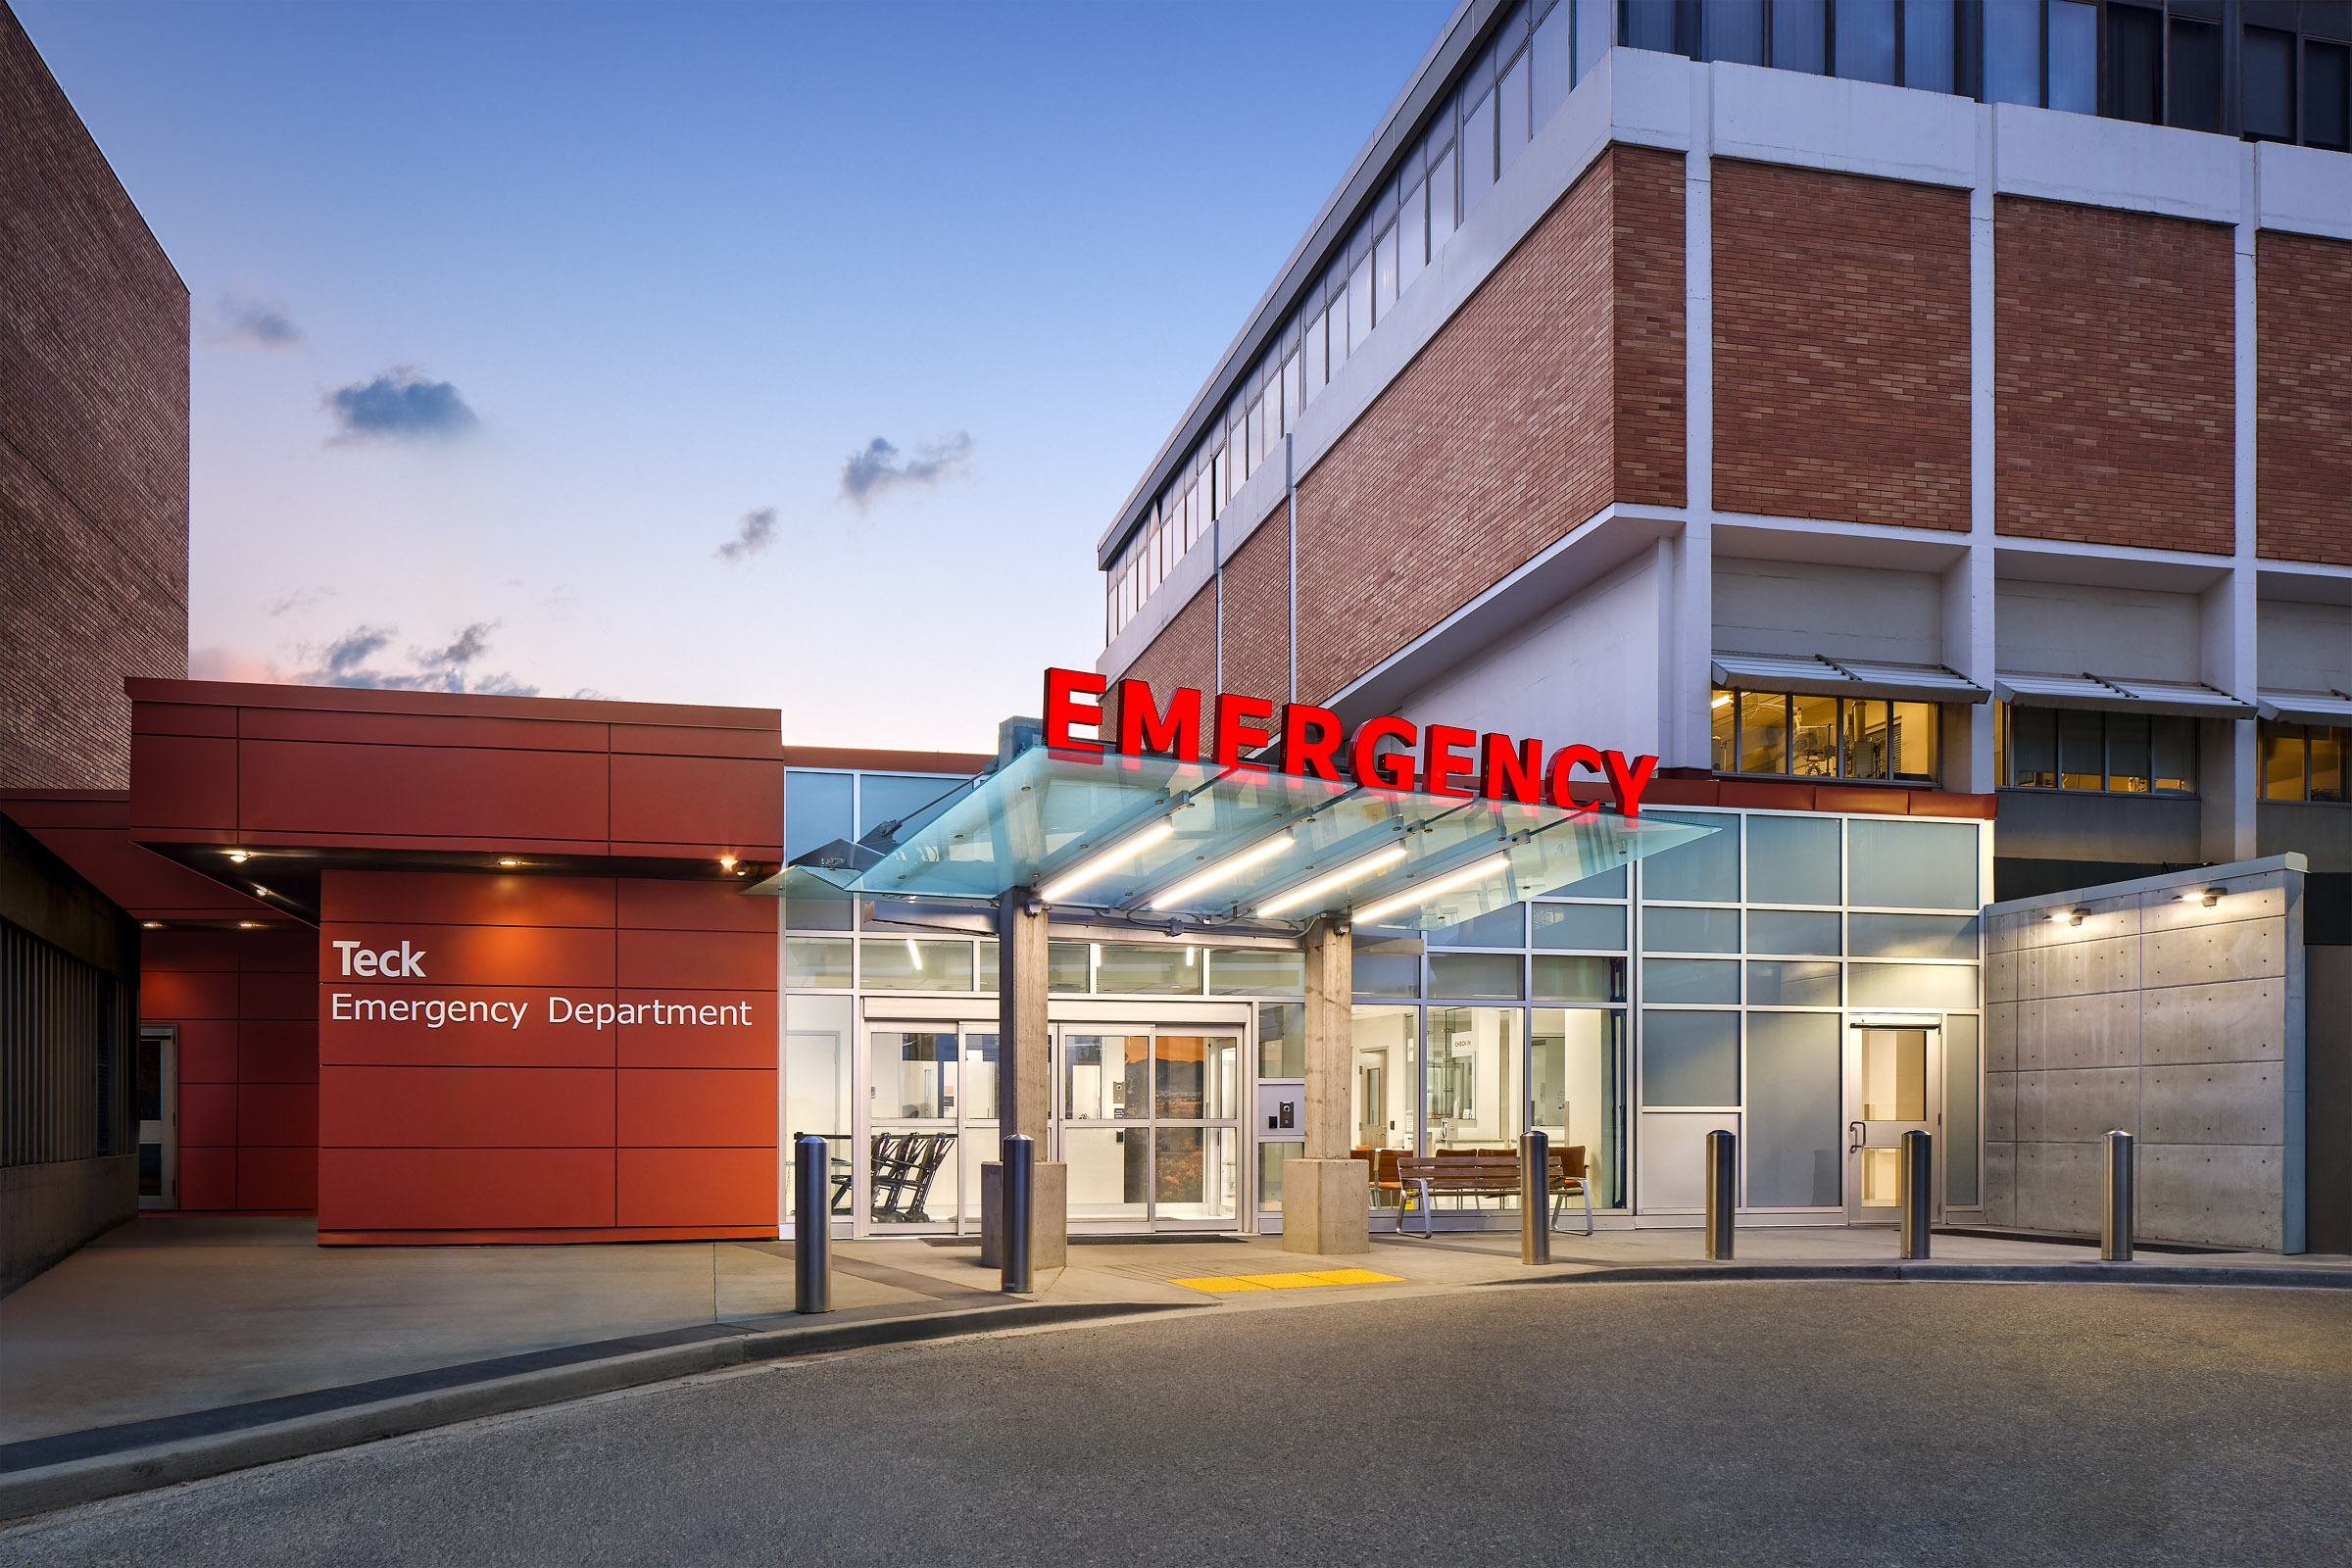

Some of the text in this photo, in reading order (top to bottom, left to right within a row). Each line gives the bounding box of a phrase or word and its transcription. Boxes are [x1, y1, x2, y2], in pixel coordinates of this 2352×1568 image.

[1043, 667, 1659, 817] EMERGENCY
[332, 940, 426, 978] Teck
[331, 993, 753, 1030] Emergency Department
